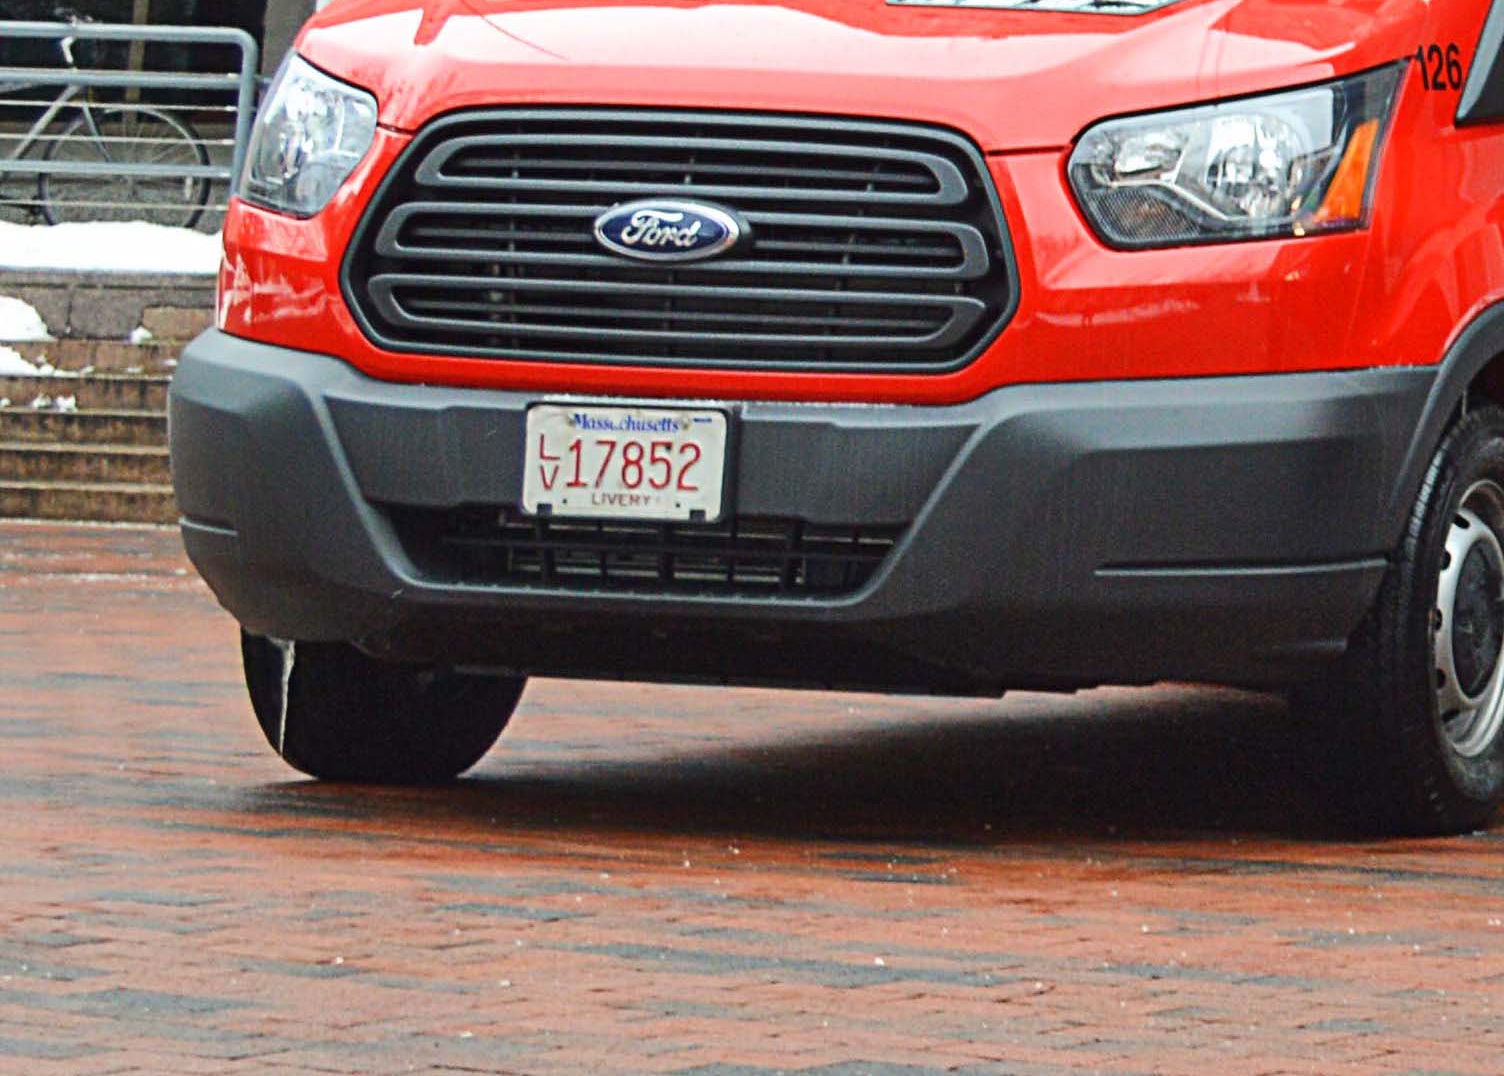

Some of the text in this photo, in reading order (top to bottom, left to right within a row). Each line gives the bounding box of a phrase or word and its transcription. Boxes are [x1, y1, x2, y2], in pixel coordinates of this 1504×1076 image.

[1416, 42, 1463, 92] 126
[621, 209, 702, 247] Ford
[566, 438, 702, 492] 17852
[591, 491, 650, 507] LIVERY
